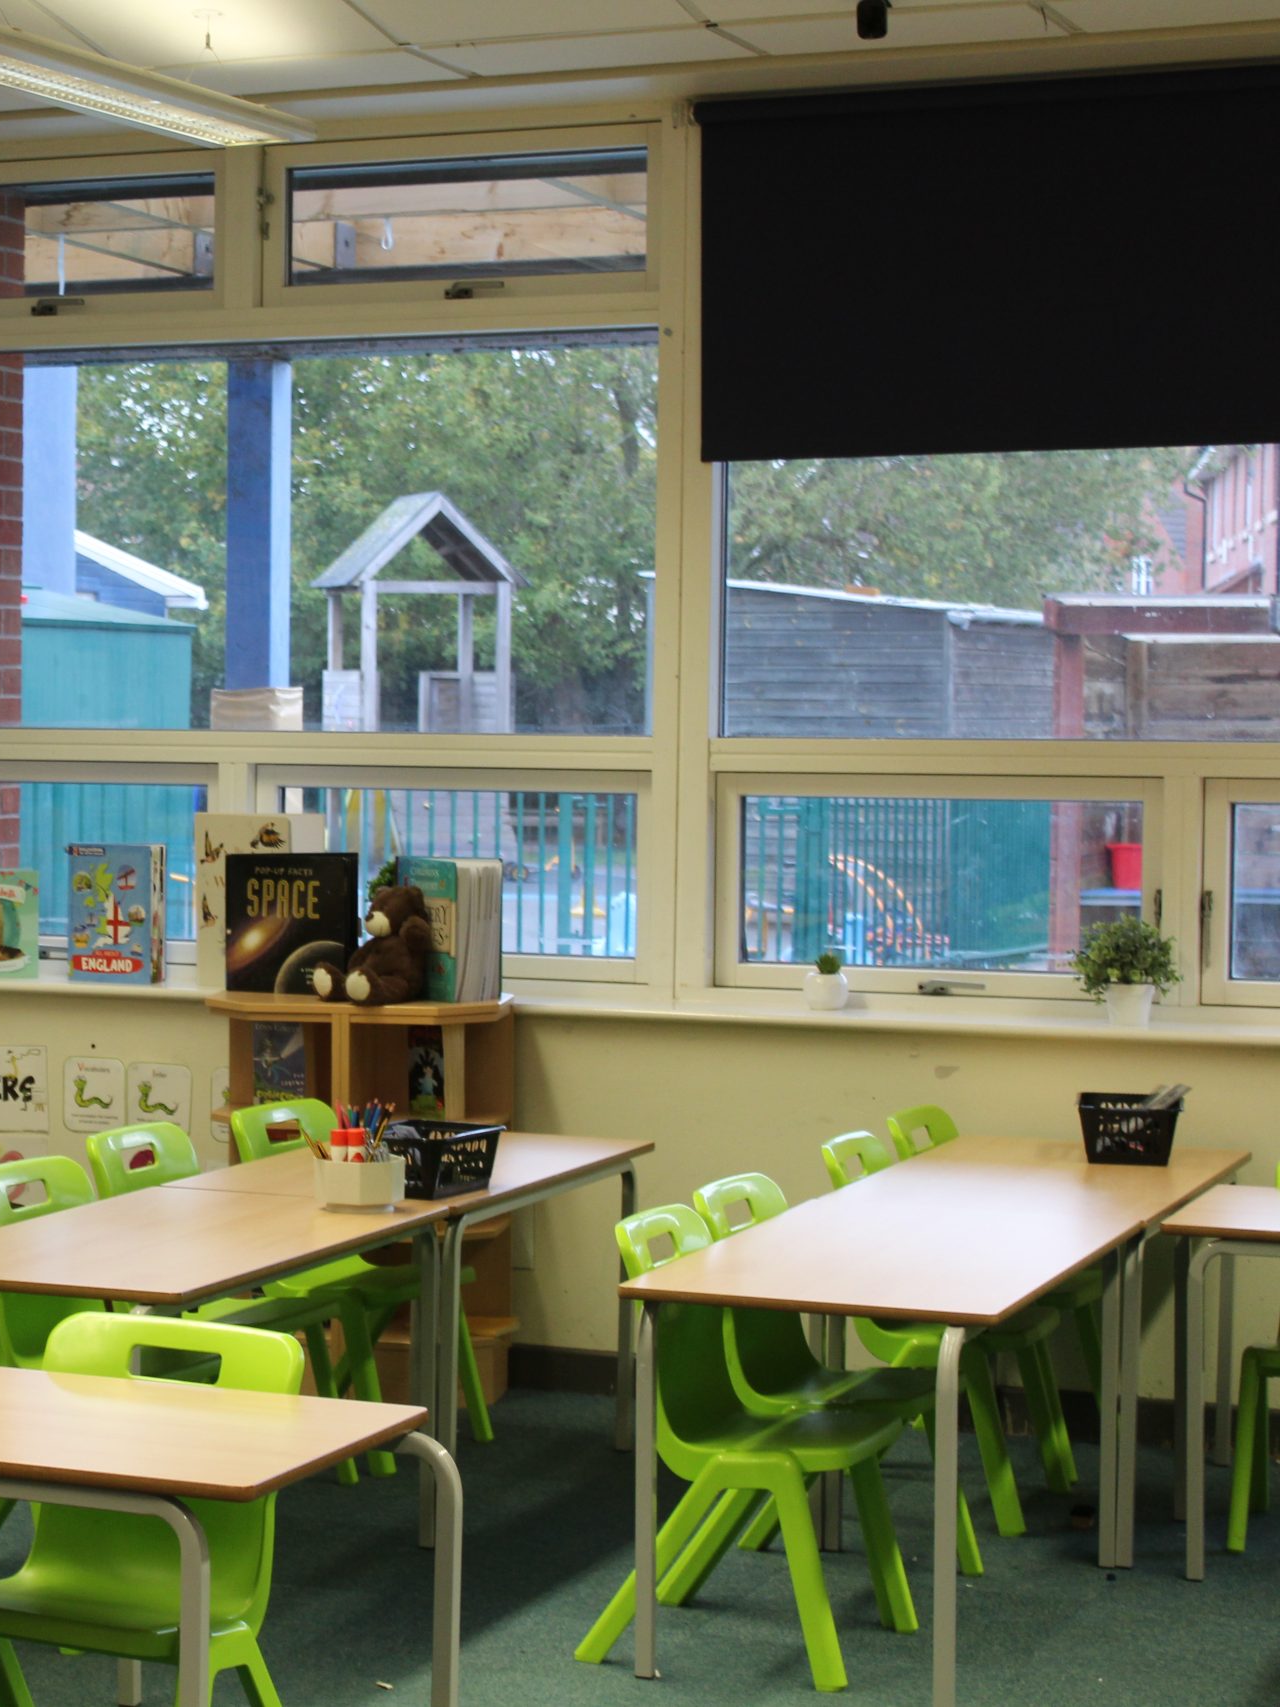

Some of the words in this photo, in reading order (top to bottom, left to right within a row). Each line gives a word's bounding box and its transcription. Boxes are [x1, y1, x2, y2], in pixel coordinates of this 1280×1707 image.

[254, 866, 285, 876] POP-UP
[287, 867, 314, 877] FACTS
[246, 878, 321, 920] SPACE
[81, 957, 133, 972] ENGLAND
